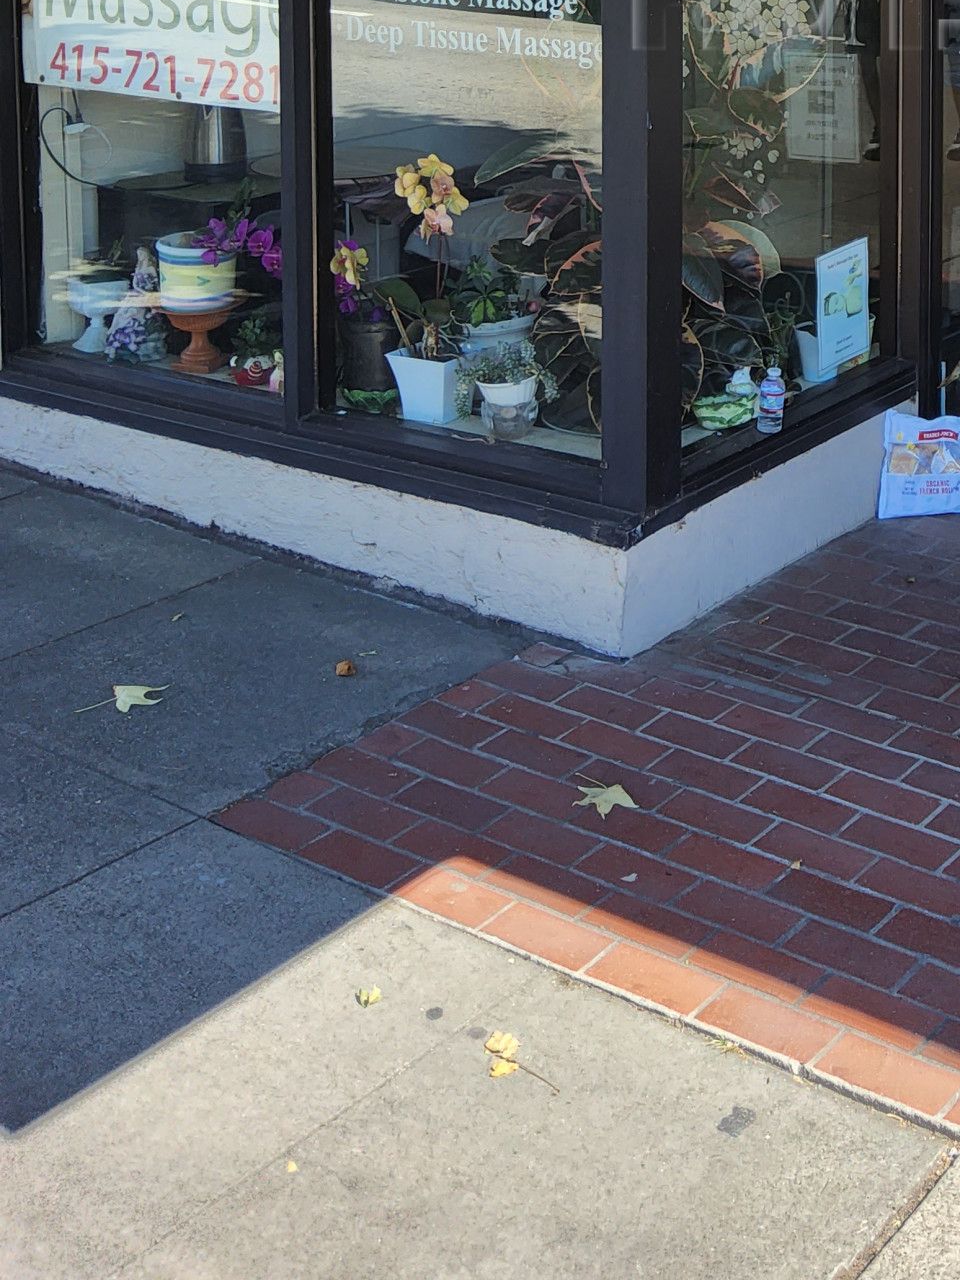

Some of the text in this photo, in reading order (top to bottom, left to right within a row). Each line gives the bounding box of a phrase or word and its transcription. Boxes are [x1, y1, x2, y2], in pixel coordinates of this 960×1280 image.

[346, 15, 404, 53] Deep
[411, 20, 489, 52] Tissue
[50, 42, 279, 105] 415-721-7281
